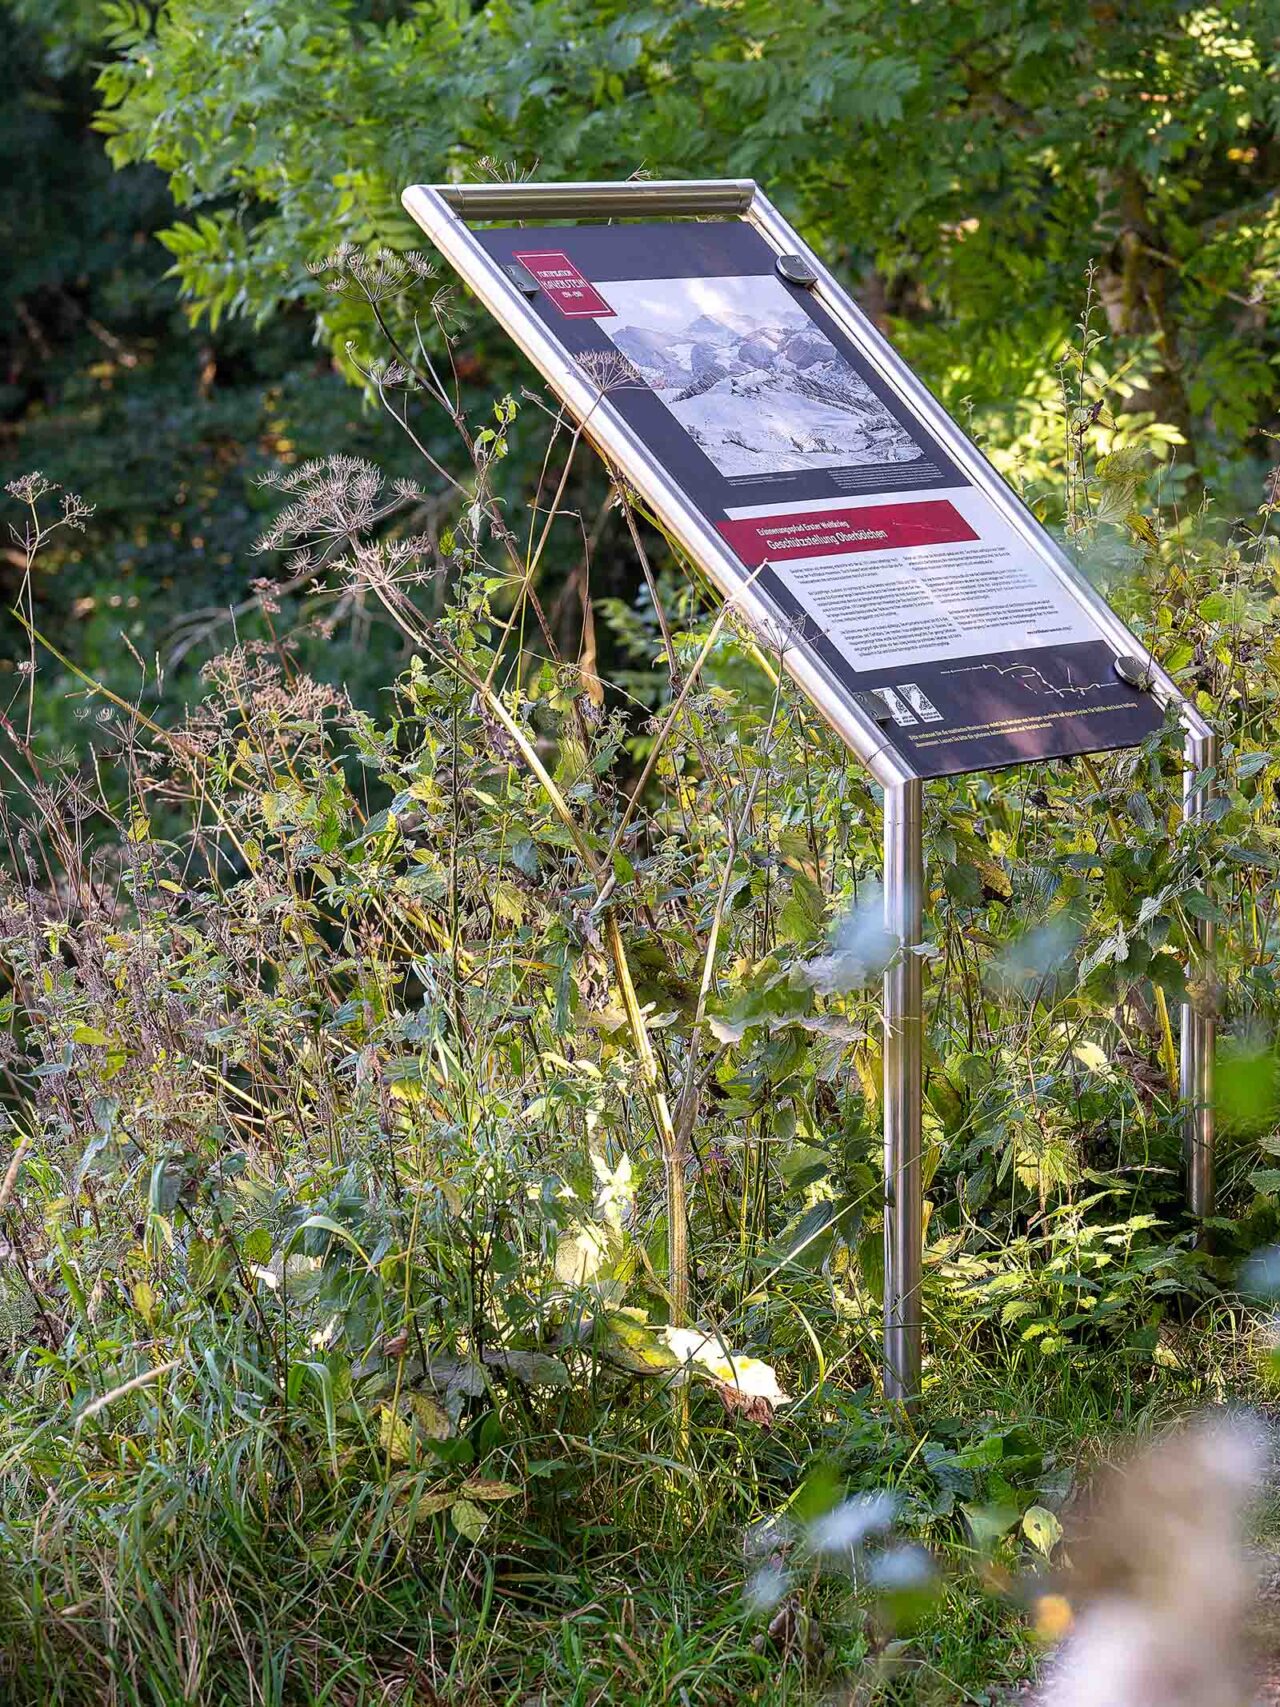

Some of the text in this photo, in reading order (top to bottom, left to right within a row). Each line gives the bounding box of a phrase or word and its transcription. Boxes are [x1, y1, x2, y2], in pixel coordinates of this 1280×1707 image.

[802, 523, 822, 532] Erster
[766, 529, 888, 550] Geschützstellung Oberbölchen
